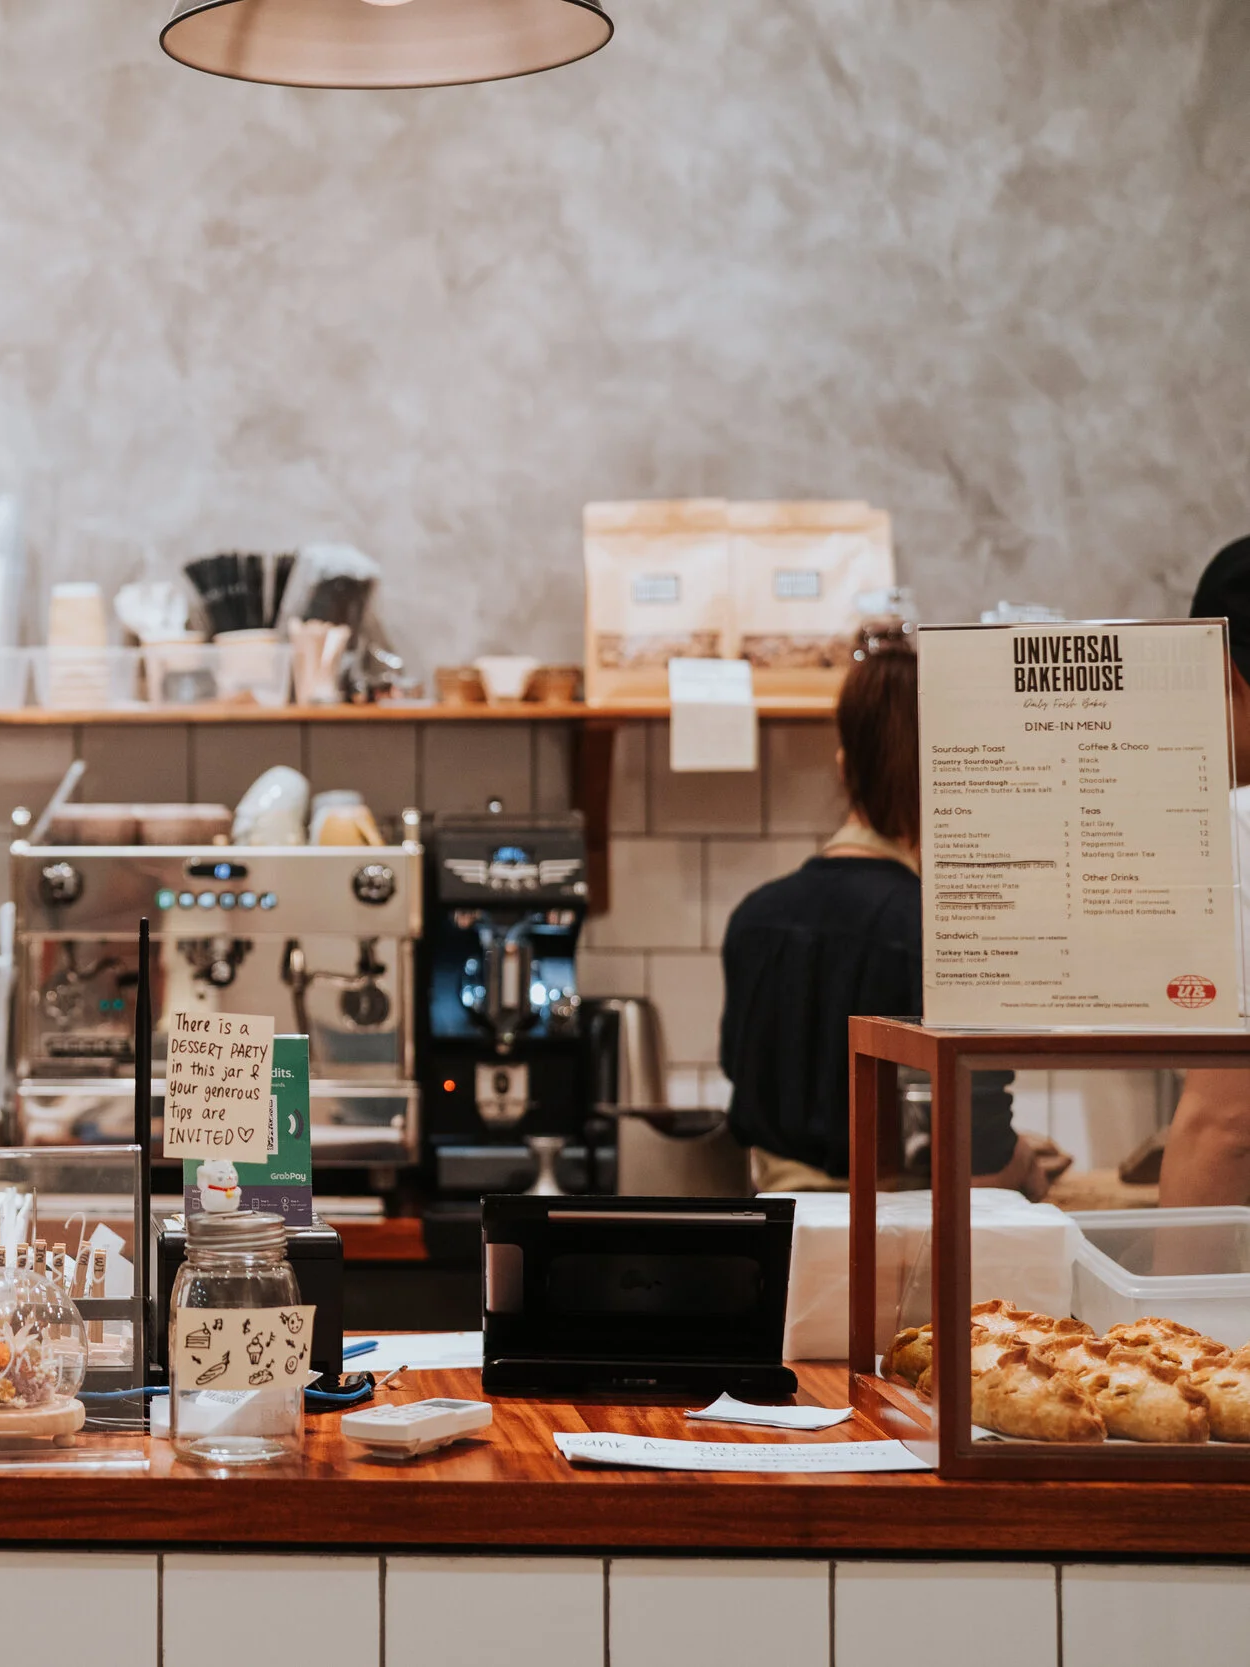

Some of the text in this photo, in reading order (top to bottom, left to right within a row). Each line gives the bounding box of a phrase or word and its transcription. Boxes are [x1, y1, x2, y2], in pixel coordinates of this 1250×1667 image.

[1013, 634, 1122, 664] UNIVERSAL
[1014, 665, 1124, 692] BAKEHOUSE
[1023, 696, 1108, 710] Daily Fresh Bakes
[1024, 721, 1112, 732] DINE-IN MENU
[932, 744, 1006, 754] Sourdough Toast
[1078, 743, 1109, 751] Coffee
[1120, 742, 1150, 750] Choco
[934, 807, 972, 816] Add Ons
[1080, 806, 1101, 815] Teas
[1082, 873, 1139, 882] Other Drinks
[935, 932, 978, 940] Sandwich
[175, 1012, 250, 1036] There is a
[171, 1038, 269, 1063] DESSERT PARTY
[171, 1058, 182, 1074] in
[190, 1060, 214, 1076] this
[221, 1066, 244, 1082] jar
[170, 1080, 260, 1102] your generous
[170, 1100, 226, 1121] tips are
[168, 1126, 234, 1146] INVITED
[270, 1172, 306, 1182] GrabPay
